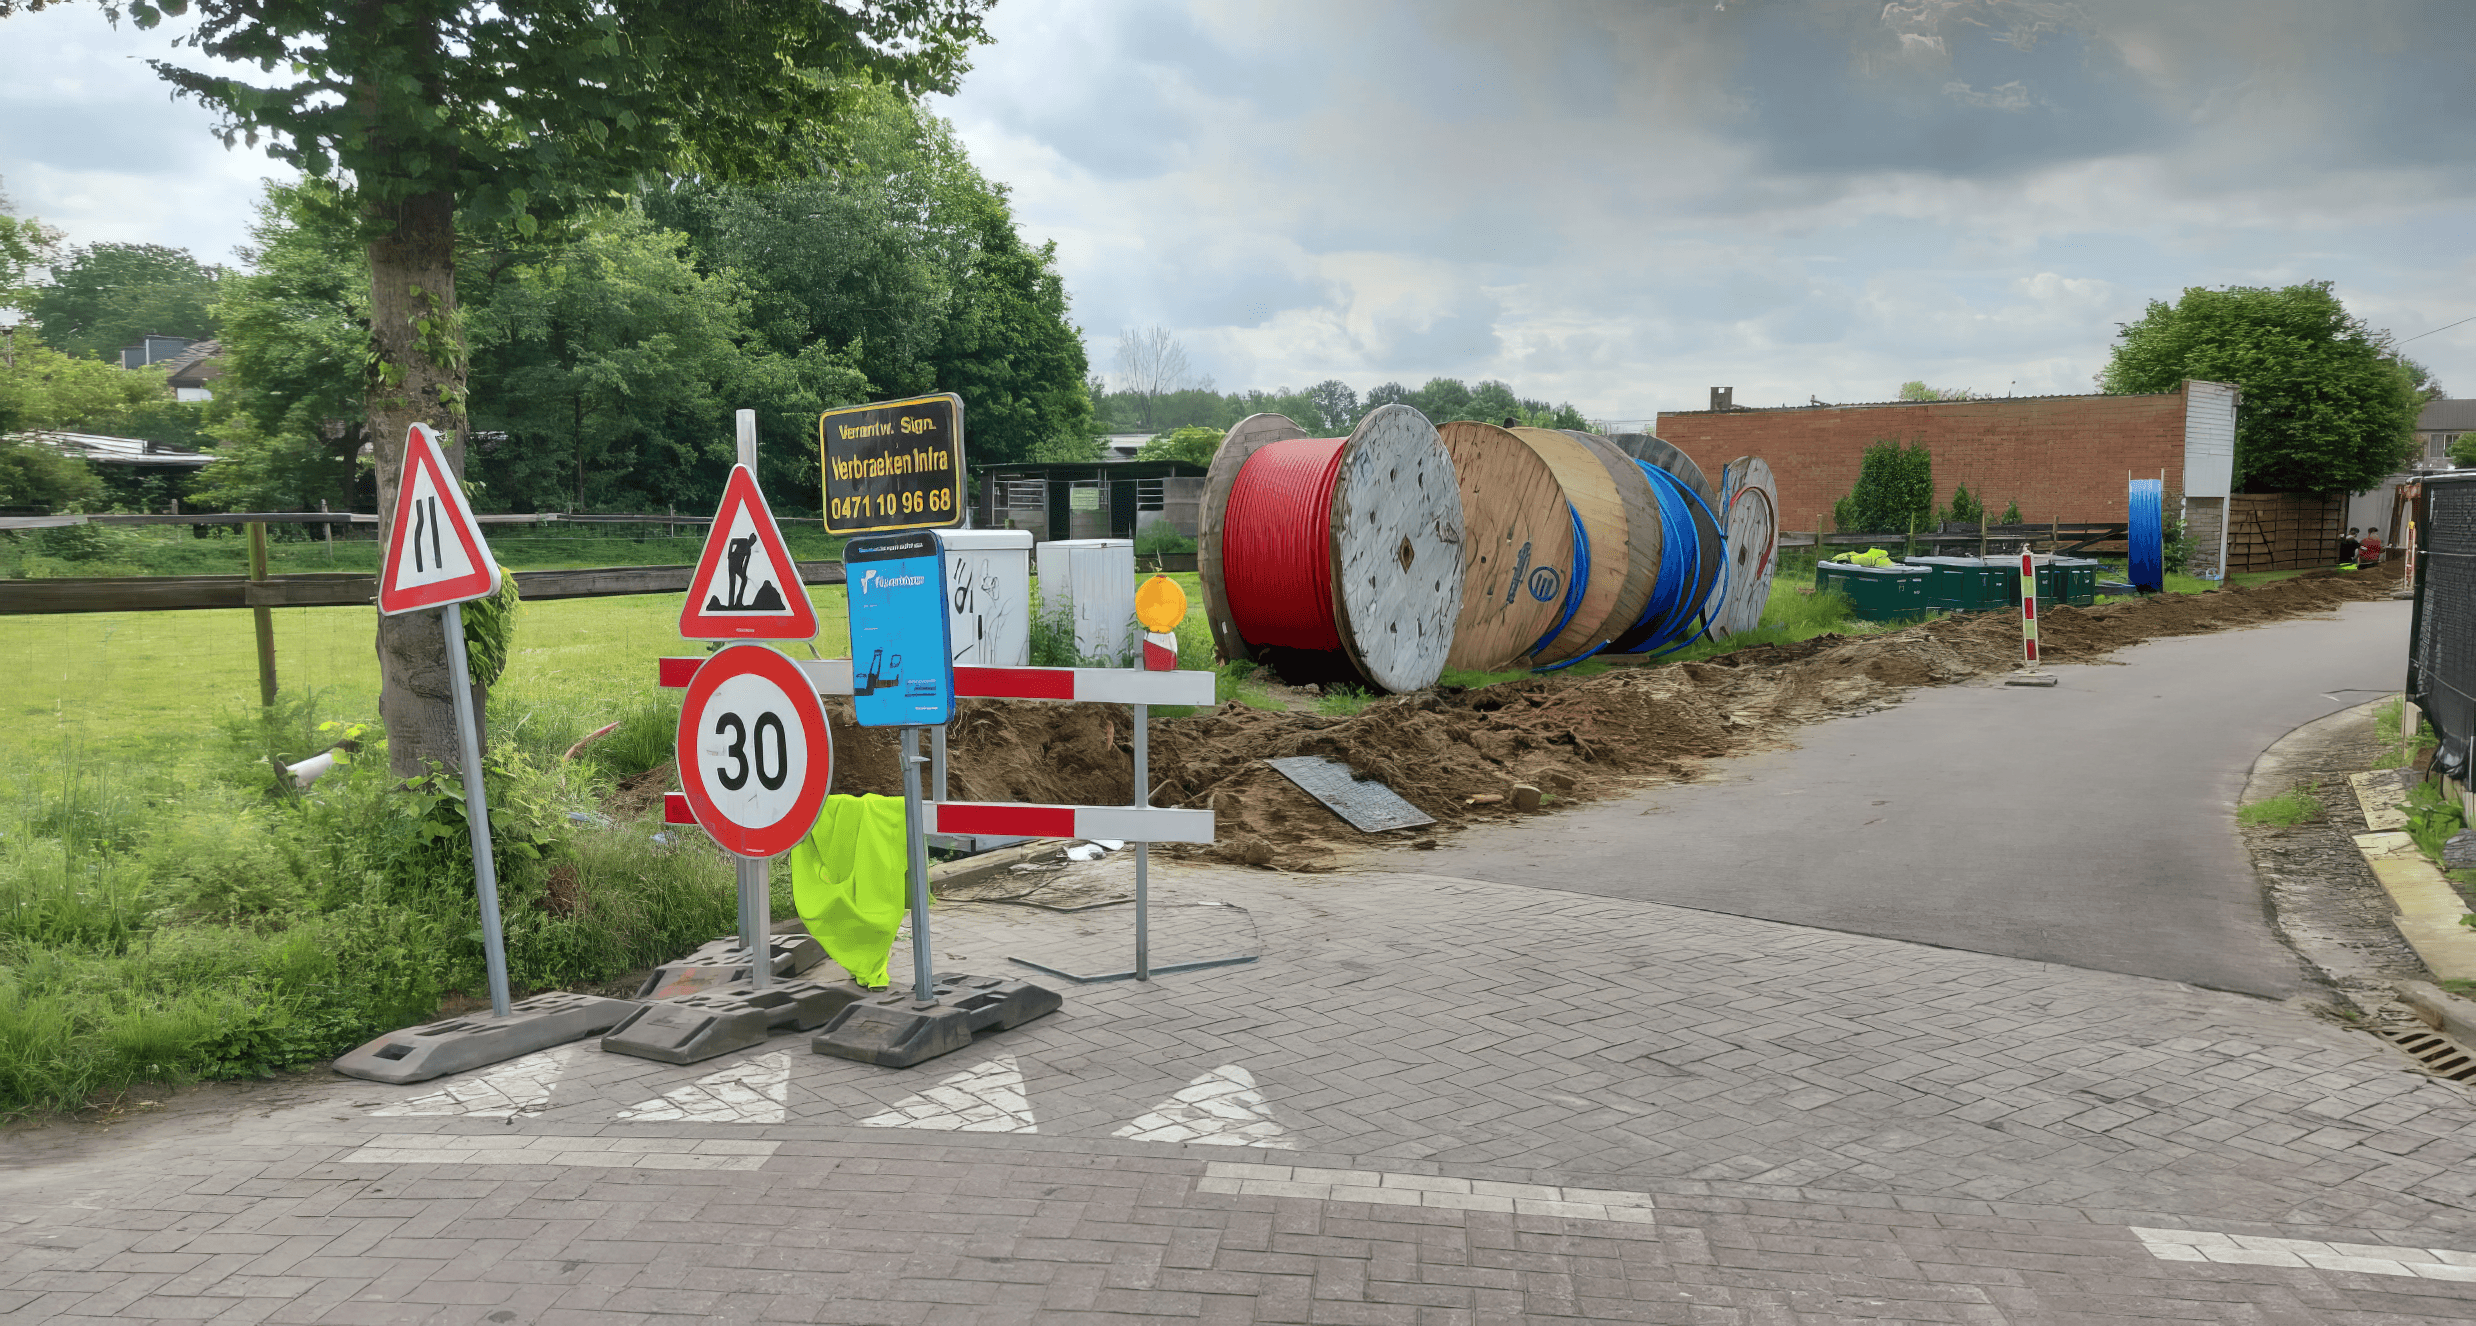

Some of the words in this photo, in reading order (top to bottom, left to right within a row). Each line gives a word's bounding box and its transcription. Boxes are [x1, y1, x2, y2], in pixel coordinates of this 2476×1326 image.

[900, 415, 937, 435] Sign.
[831, 450, 912, 481] Verbraeken
[912, 446, 949, 473] Infra
[831, 495, 871, 520] 0471
[876, 493, 897, 516] 10
[901, 491, 924, 514] 96
[929, 488, 951, 512] 68
[715, 711, 788, 791] 30
